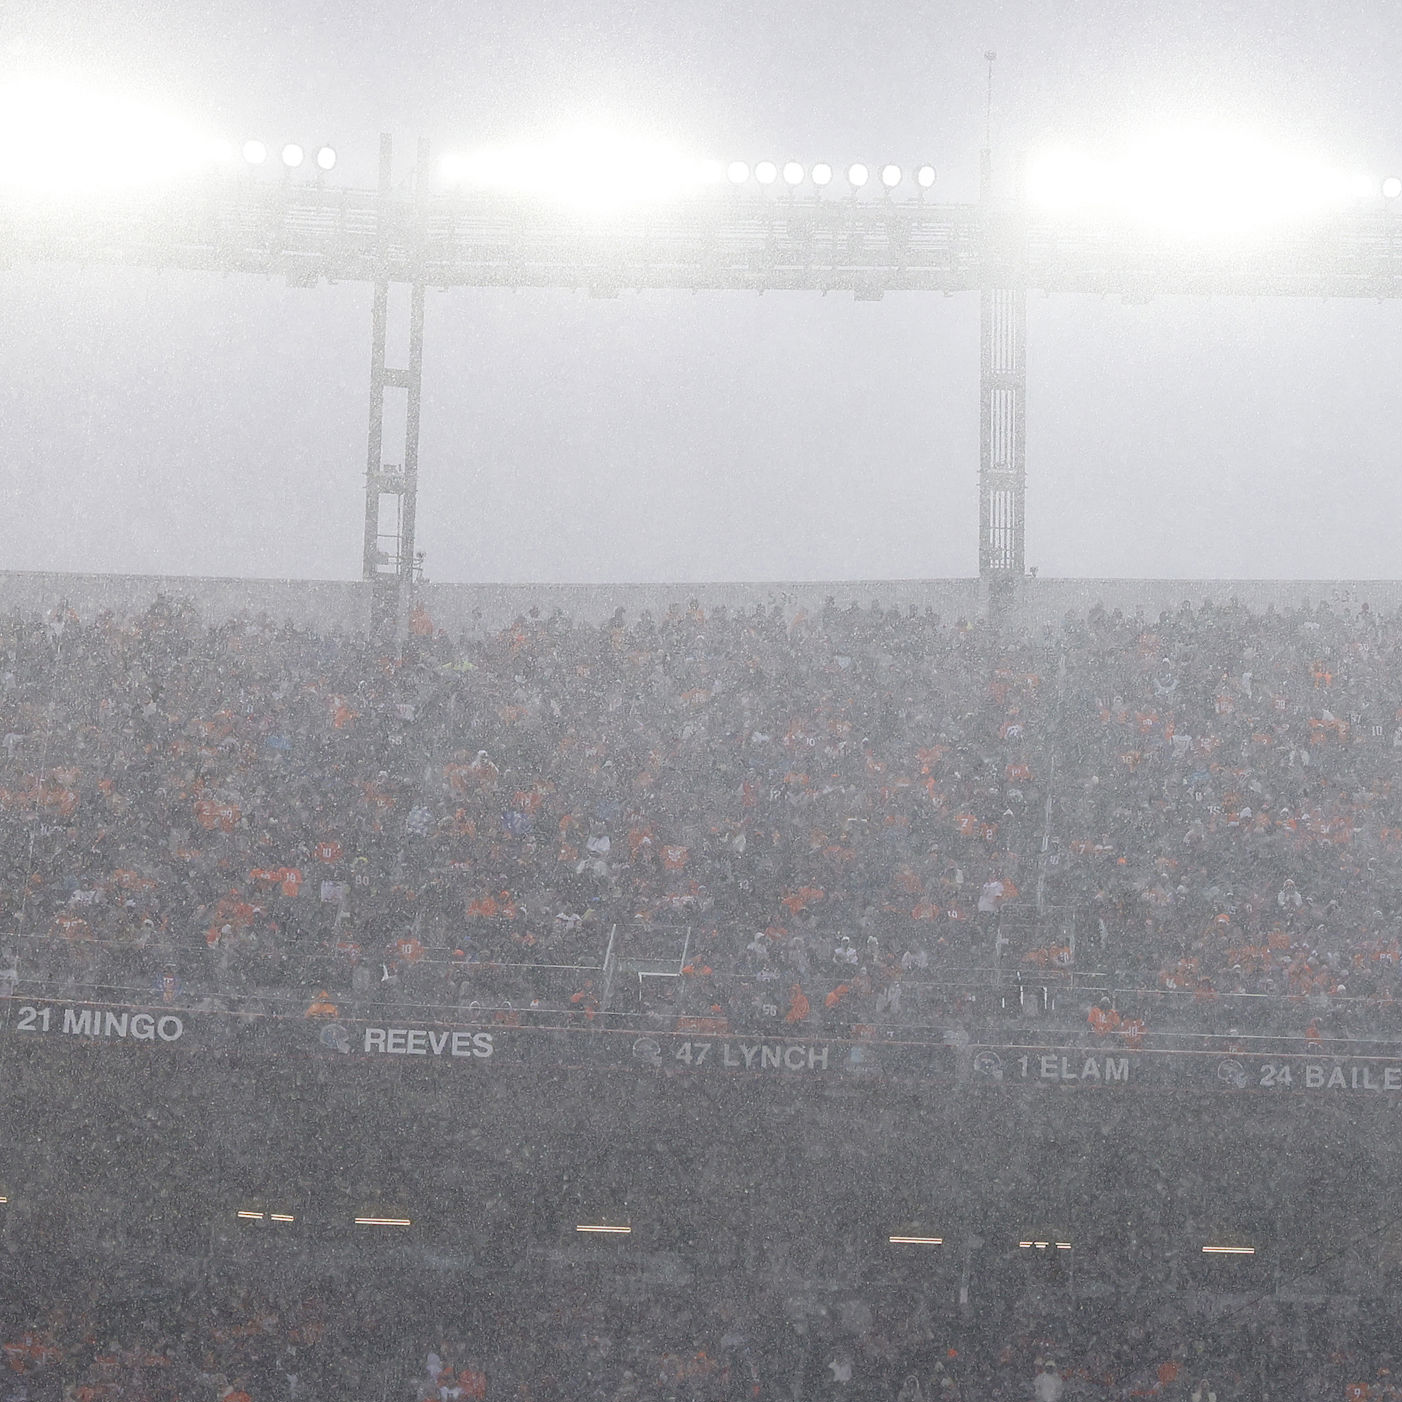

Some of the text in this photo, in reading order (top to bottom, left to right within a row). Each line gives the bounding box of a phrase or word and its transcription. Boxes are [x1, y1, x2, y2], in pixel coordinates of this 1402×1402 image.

[17, 1006, 183, 1042] 21 MINGO
[363, 1028, 493, 1057] REEVES
[675, 1042, 829, 1070] 47 LYNCH
[1018, 1055, 1130, 1082] 1 ELAM
[1260, 1064, 1293, 1086] 24
